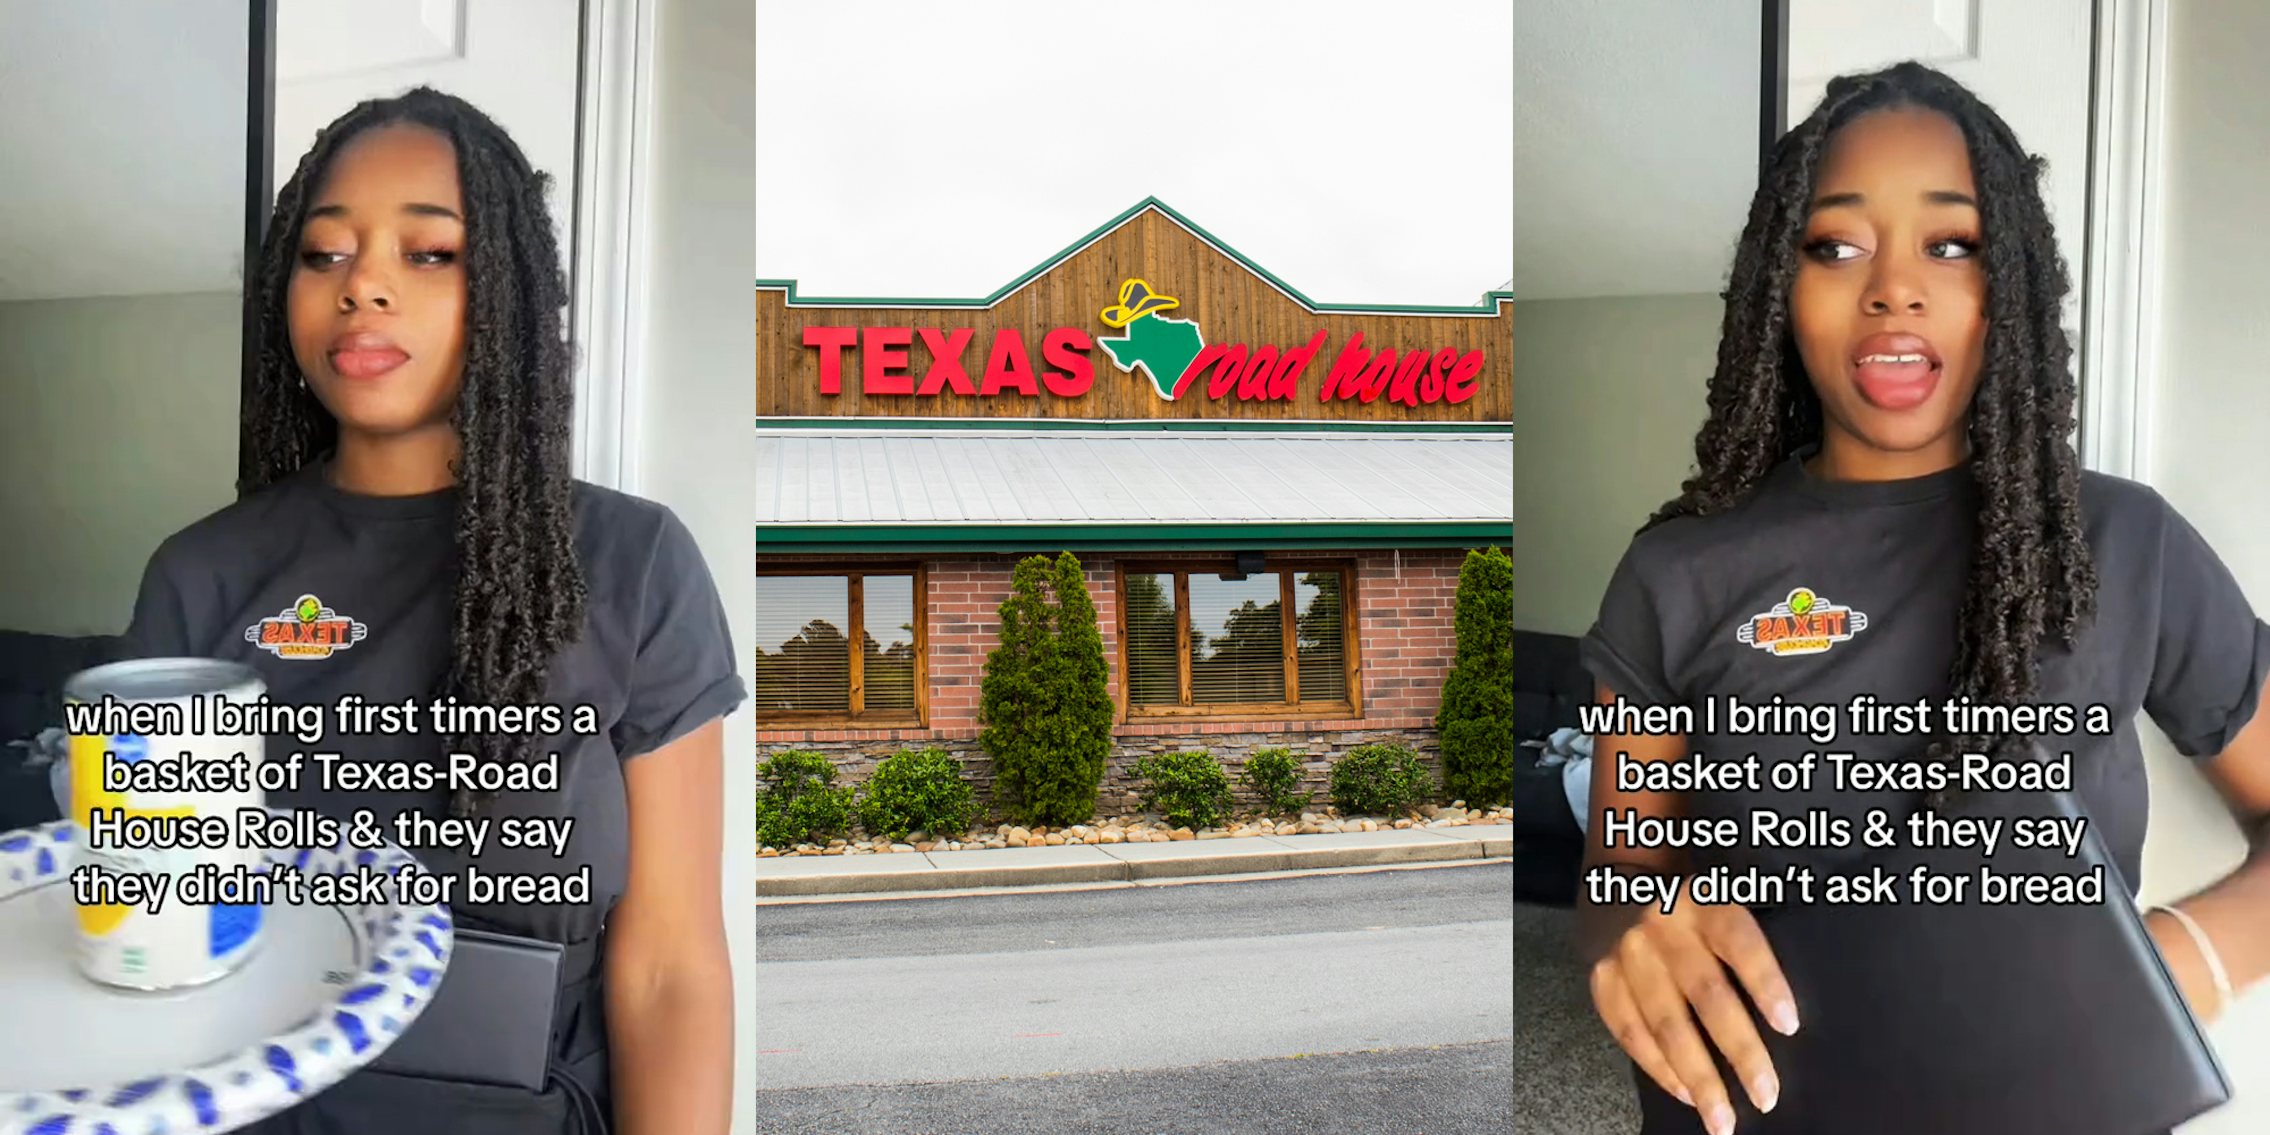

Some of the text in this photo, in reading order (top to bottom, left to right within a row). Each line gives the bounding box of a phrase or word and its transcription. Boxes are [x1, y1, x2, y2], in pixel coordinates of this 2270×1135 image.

[802, 326, 1484, 407] TEXAS road house
